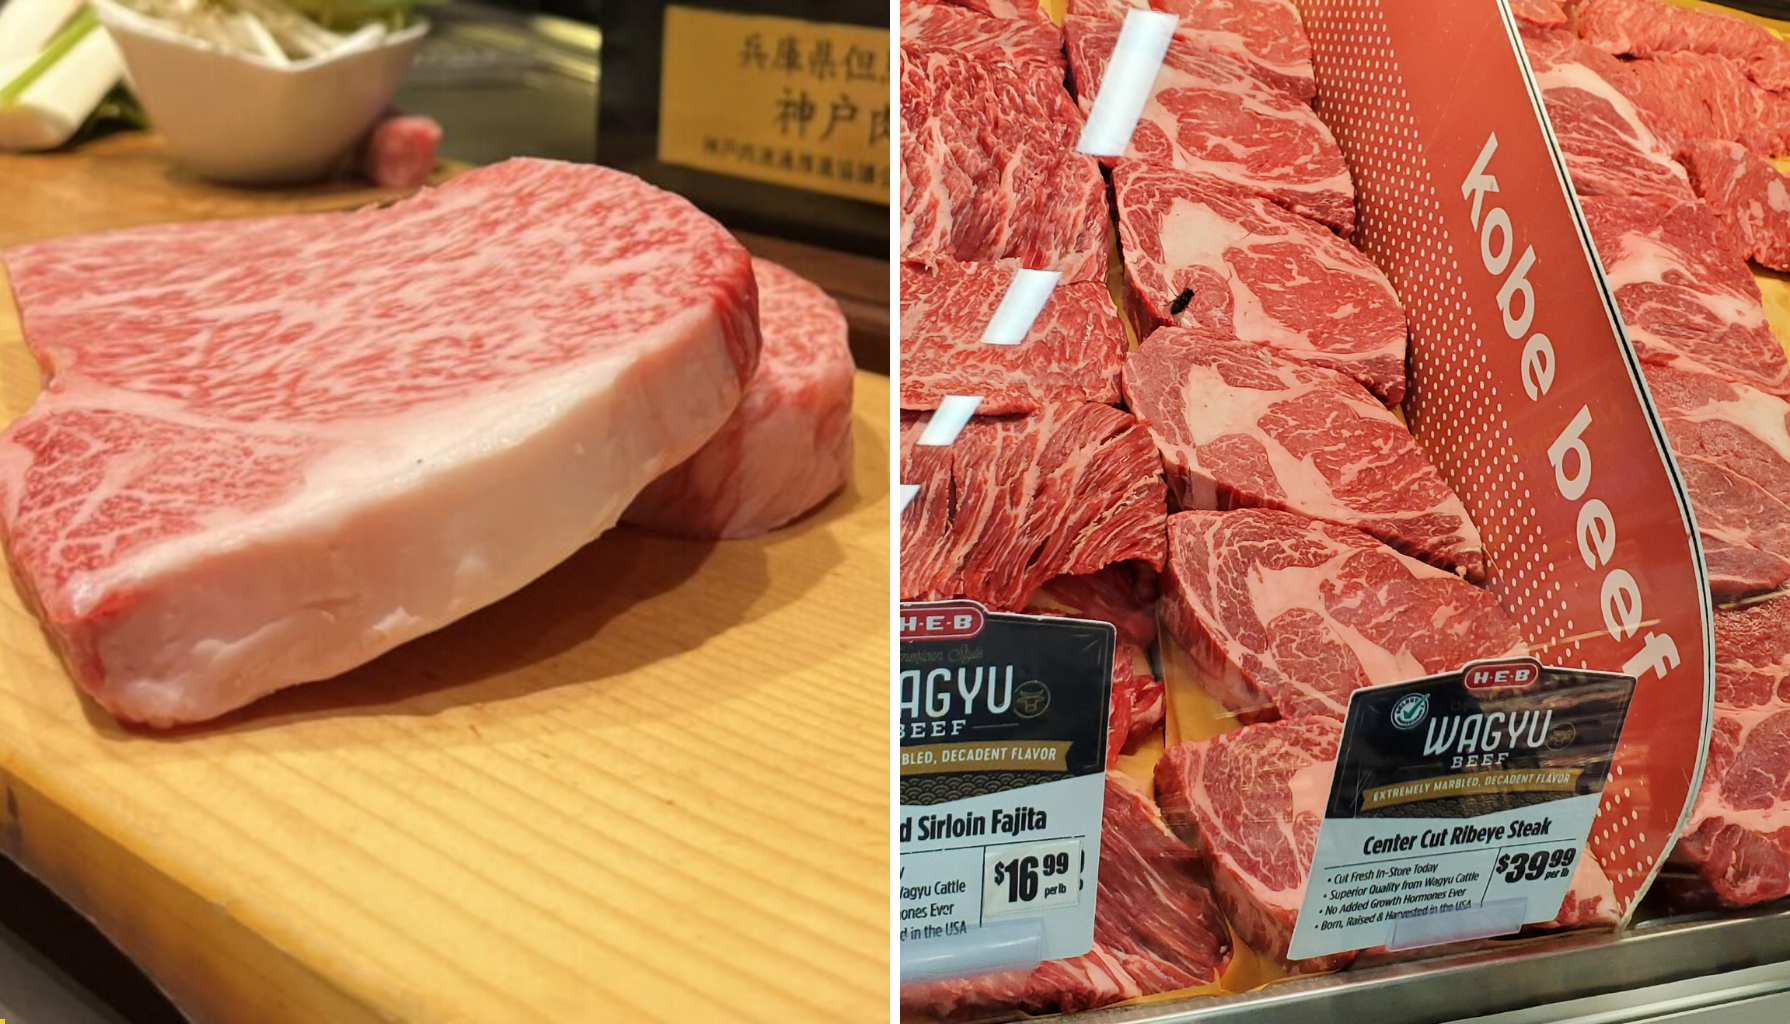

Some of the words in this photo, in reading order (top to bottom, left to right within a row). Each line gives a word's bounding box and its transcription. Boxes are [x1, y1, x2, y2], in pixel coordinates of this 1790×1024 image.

[739, 33, 890, 84] 兵庫県但
[1462, 132, 1556, 402] kobe
[1547, 404, 1681, 680] beef
[1423, 709, 1553, 757] WAGYU
[942, 747, 1008, 763] DECADENT
[1011, 748, 1056, 761] FLAVOR
[1451, 752, 1509, 769] BEEF
[1373, 781, 1431, 802] EXTREMELY
[1433, 774, 1482, 791] MARBLED,
[1485, 771, 1534, 788] DECADENT
[1536, 770, 1571, 785] FLAVOR
[917, 812, 985, 841] Sirloin
[991, 807, 1047, 836] Fajita
[1363, 834, 1418, 856] Center
[1420, 829, 1449, 850] Cut
[1450, 822, 1505, 846] Ribeye
[1507, 817, 1552, 839] Steak
[934, 879, 966, 895] Cattle
[1329, 886, 1368, 901] Superior
[1369, 880, 1400, 895] Quality
[1401, 878, 1423, 891] from
[1425, 876, 1454, 888] Wagyu
[1455, 871, 1480, 883] Cattle
[1334, 873, 1349, 885] Cut
[1350, 869, 1374, 882] Fresh
[1375, 865, 1412, 879] In-Store
[1413, 861, 1439, 874] Today
[1544, 870, 1560, 881] per
[1560, 867, 1569, 877] lb
[1044, 886, 1058, 899] per
[1058, 883, 1067, 895] lb
[1325, 905, 1338, 916] No
[1339, 901, 1369, 914] Added
[1370, 897, 1402, 910] Growth
[1403, 892, 1447, 905] Hormones
[1447, 888, 1468, 899] Ever
[930, 902, 954, 917] Ever
[1320, 919, 1344, 931] Born,
[1346, 912, 1376, 926] Raised
[1376, 911, 1384, 922] &
[1384, 907, 1429, 921] Harvested
[1429, 906, 1438, 914] in
[1440, 903, 1455, 912] the
[1455, 899, 1472, 911] USA
[911, 926, 921, 940] in
[924, 925, 942, 939] the
[946, 920, 967, 936] USA
